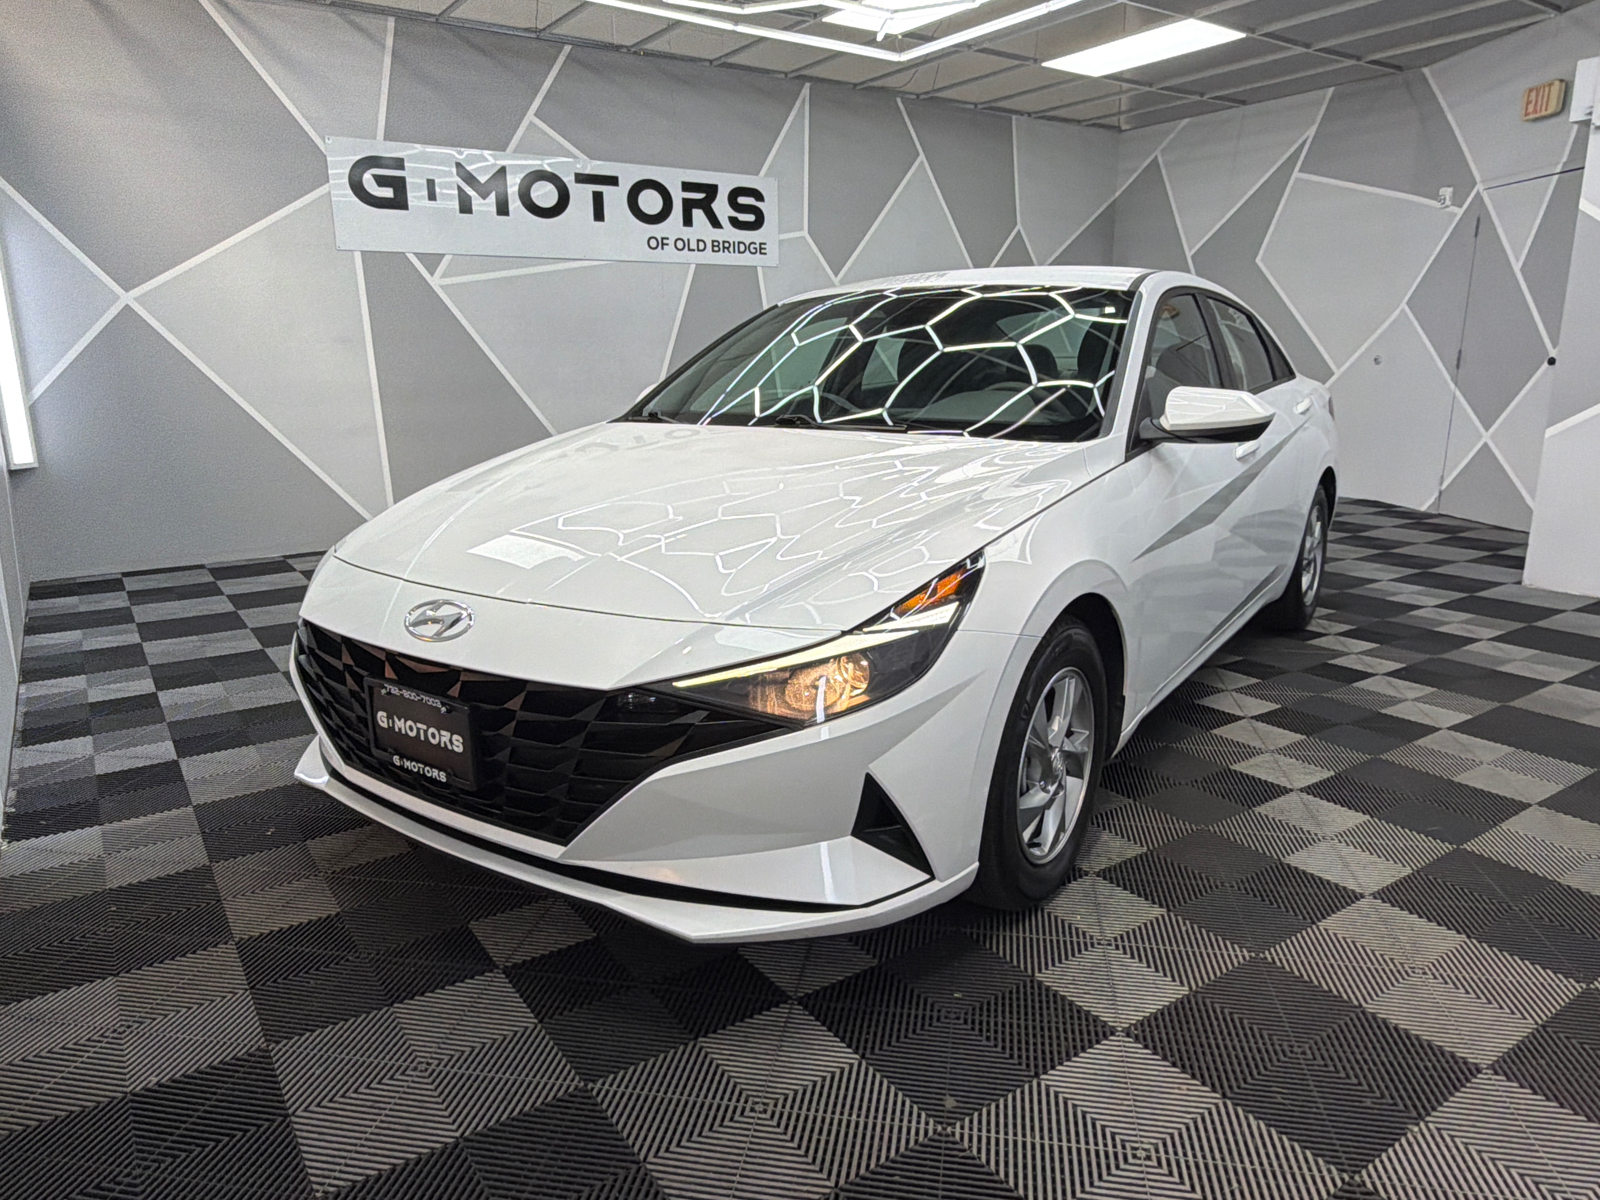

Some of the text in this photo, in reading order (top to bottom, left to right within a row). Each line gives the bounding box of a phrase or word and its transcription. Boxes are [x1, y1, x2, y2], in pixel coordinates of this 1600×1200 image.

[1524, 82, 1554, 117] EXIT
[647, 236, 767, 255] OF OLD BRIDGE
